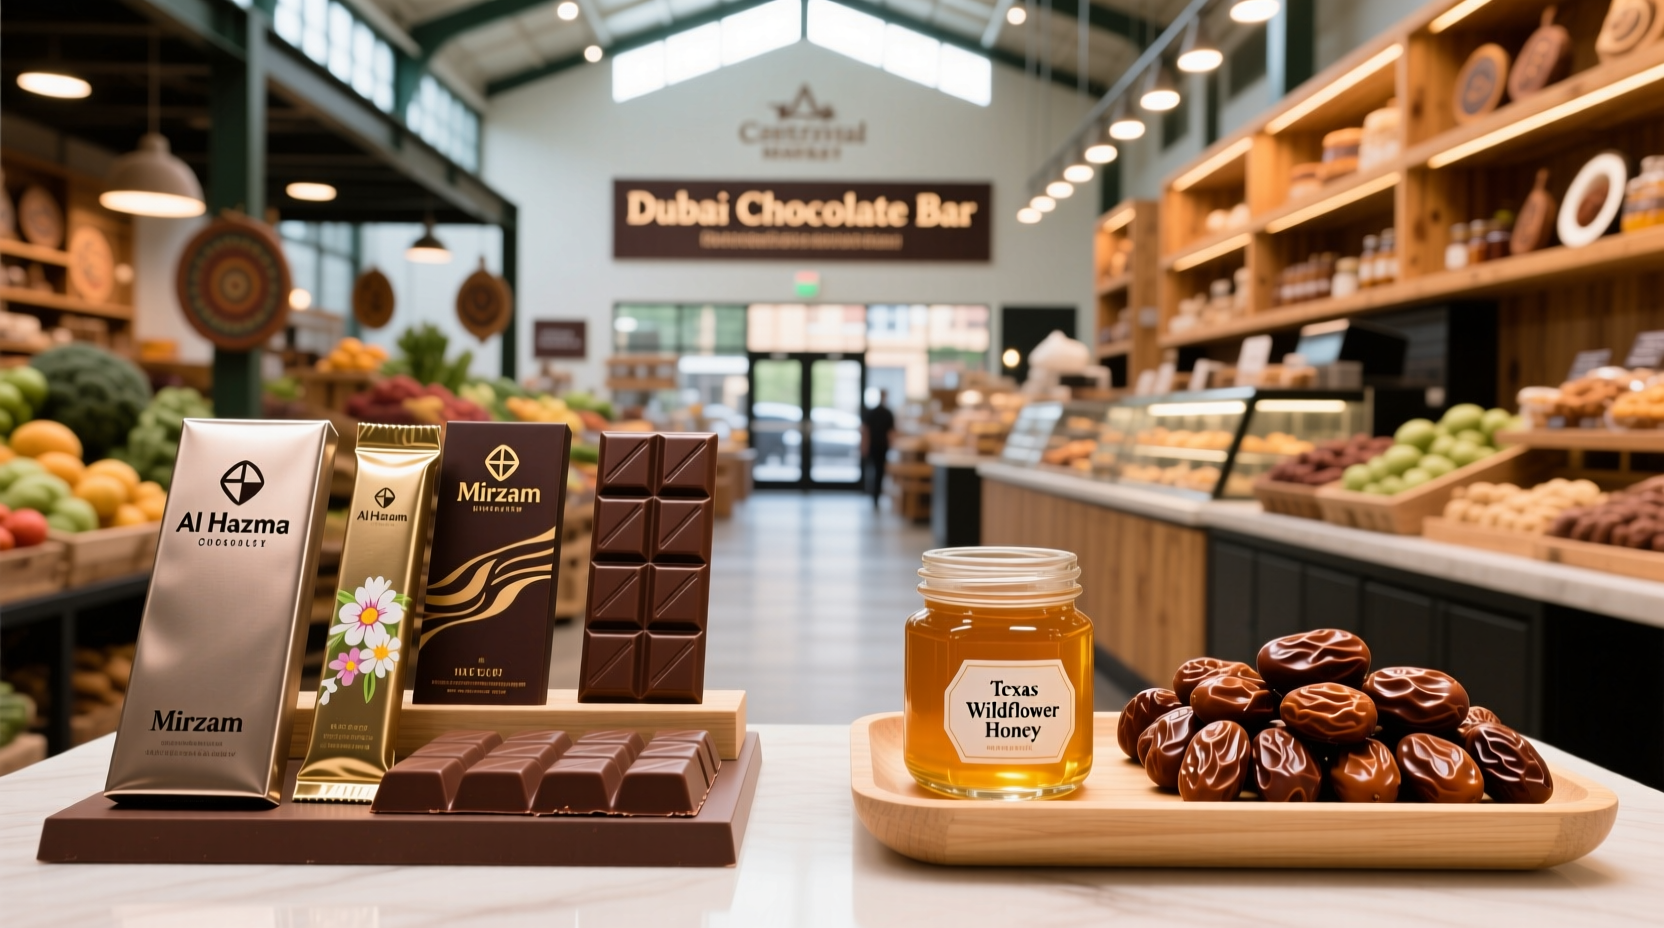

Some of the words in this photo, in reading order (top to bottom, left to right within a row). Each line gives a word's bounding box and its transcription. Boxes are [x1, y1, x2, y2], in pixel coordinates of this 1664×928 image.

[626, 189, 730, 226] Dubai
[735, 190, 909, 228] Chocolate
[915, 191, 978, 228] Bar
[457, 481, 541, 503] Mirzam
[175, 511, 202, 532] Al
[207, 511, 290, 535] Hazma
[356, 510, 369, 521] Al
[149, 709, 243, 733] Mirzam
[965, 701, 1060, 719] Wildflower
[984, 721, 1042, 743] Honey
